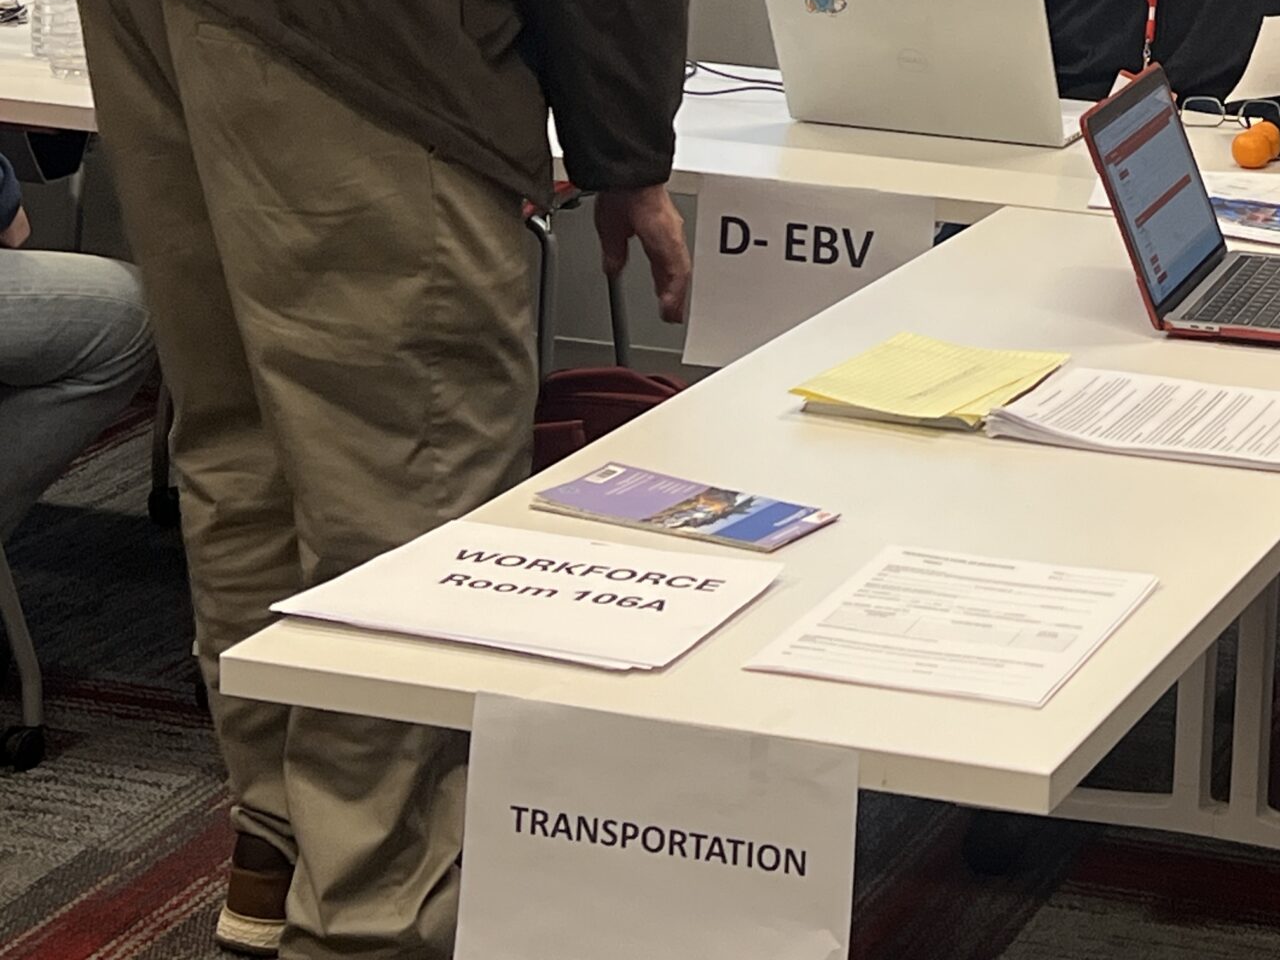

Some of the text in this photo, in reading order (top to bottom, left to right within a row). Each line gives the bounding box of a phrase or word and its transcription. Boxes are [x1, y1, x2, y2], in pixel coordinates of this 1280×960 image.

[719, 215, 875, 269] D- EBV
[438, 573, 669, 613] Room 106A
[456, 548, 726, 593] WORKFORCE
[510, 805, 808, 877] TRANSPORTATION
